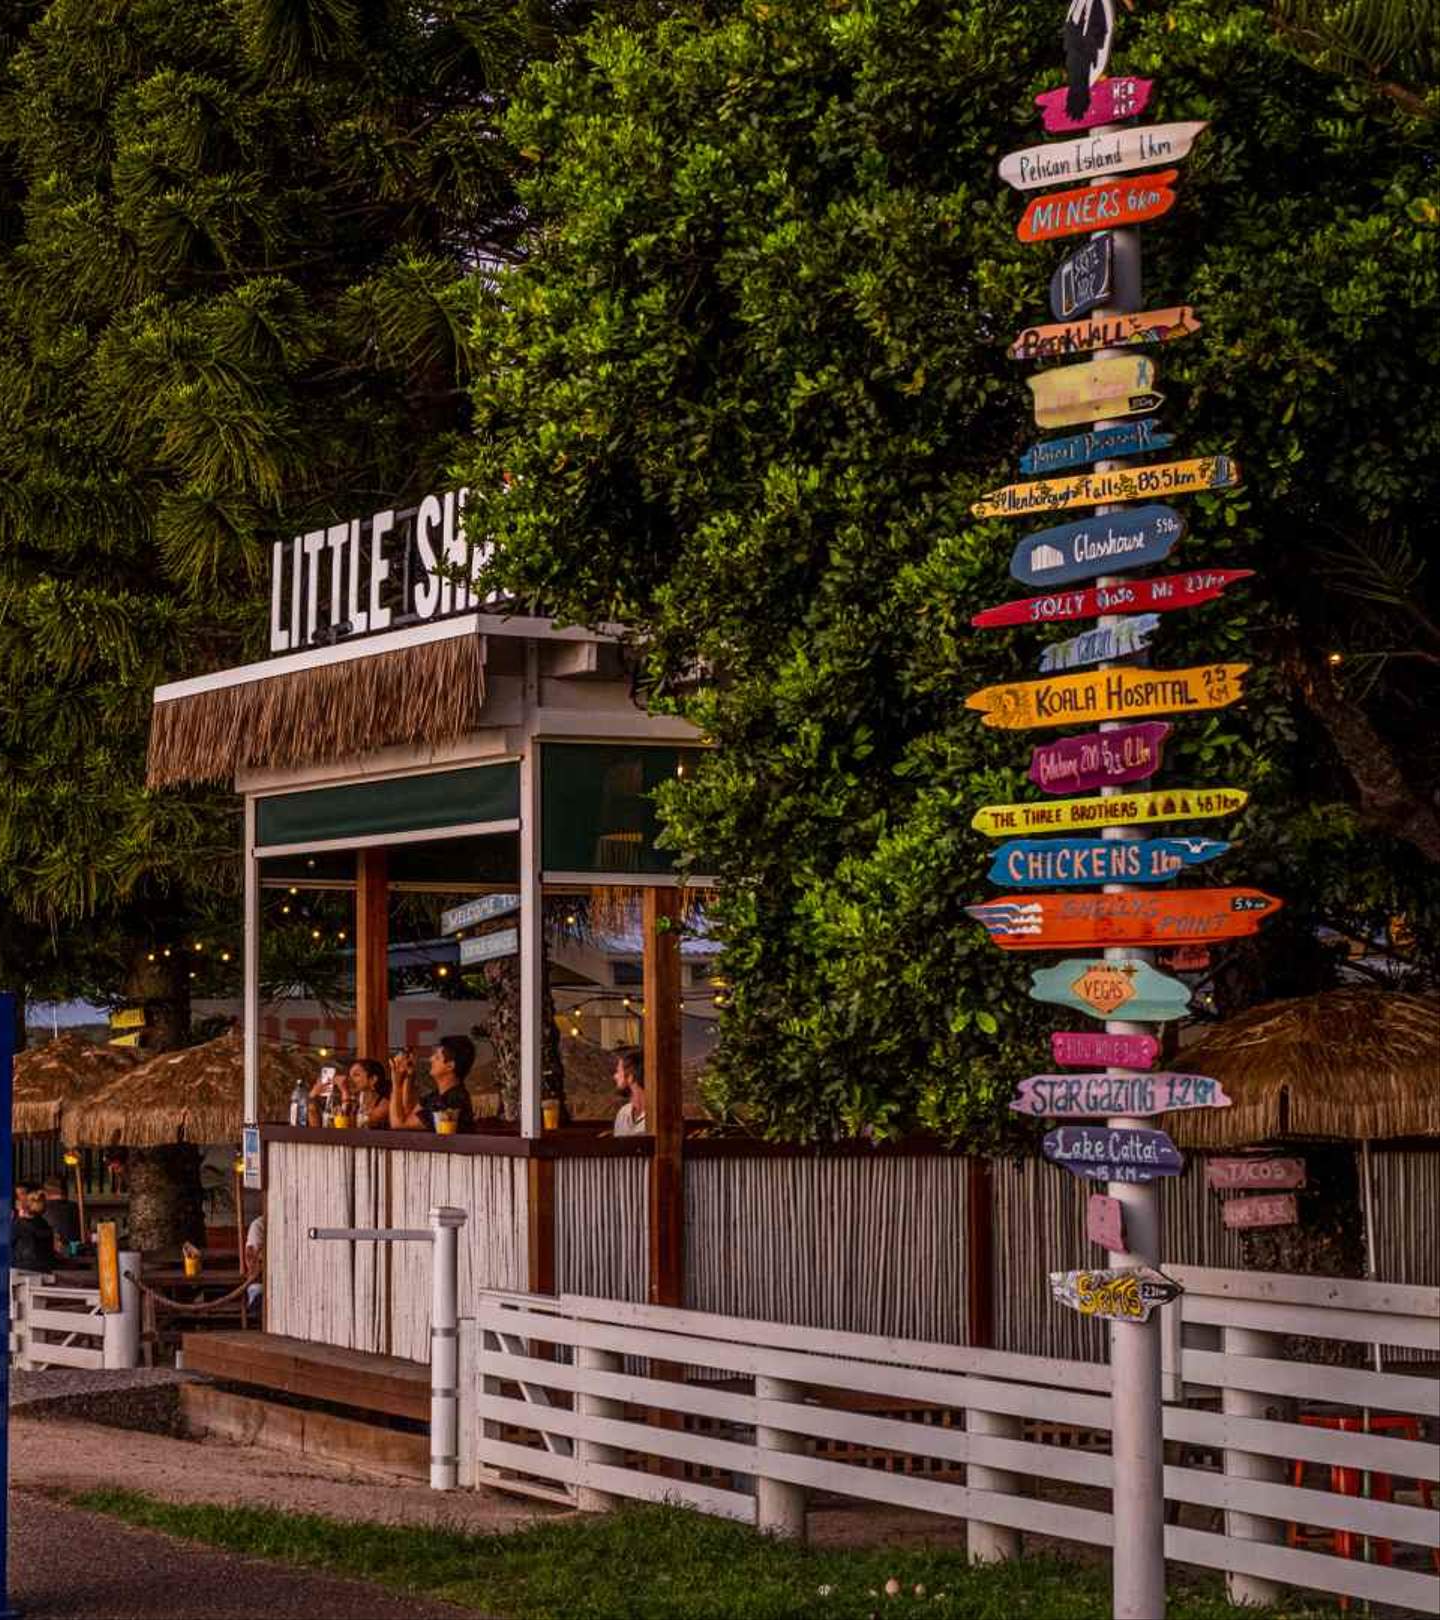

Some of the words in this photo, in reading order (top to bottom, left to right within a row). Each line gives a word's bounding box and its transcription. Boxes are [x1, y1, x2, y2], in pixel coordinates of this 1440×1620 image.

[1020, 154, 1071, 183] Pelican
[1075, 138, 1123, 174] Island
[1031, 188, 1120, 234] MINERS
[1073, 528, 1145, 563] Glasshouse
[270, 509, 394, 652] LITTLE
[1030, 595, 1085, 621] JOLLY
[1035, 684, 1097, 719] KOALA
[990, 810, 1018, 828] THE
[1023, 807, 1062, 824] THREE
[1070, 798, 1138, 821] BROTHERS
[1008, 847, 1141, 882] CHICKENS
[1083, 978, 1123, 1001] VEGAS
[1056, 1130, 1105, 1161] Lake
